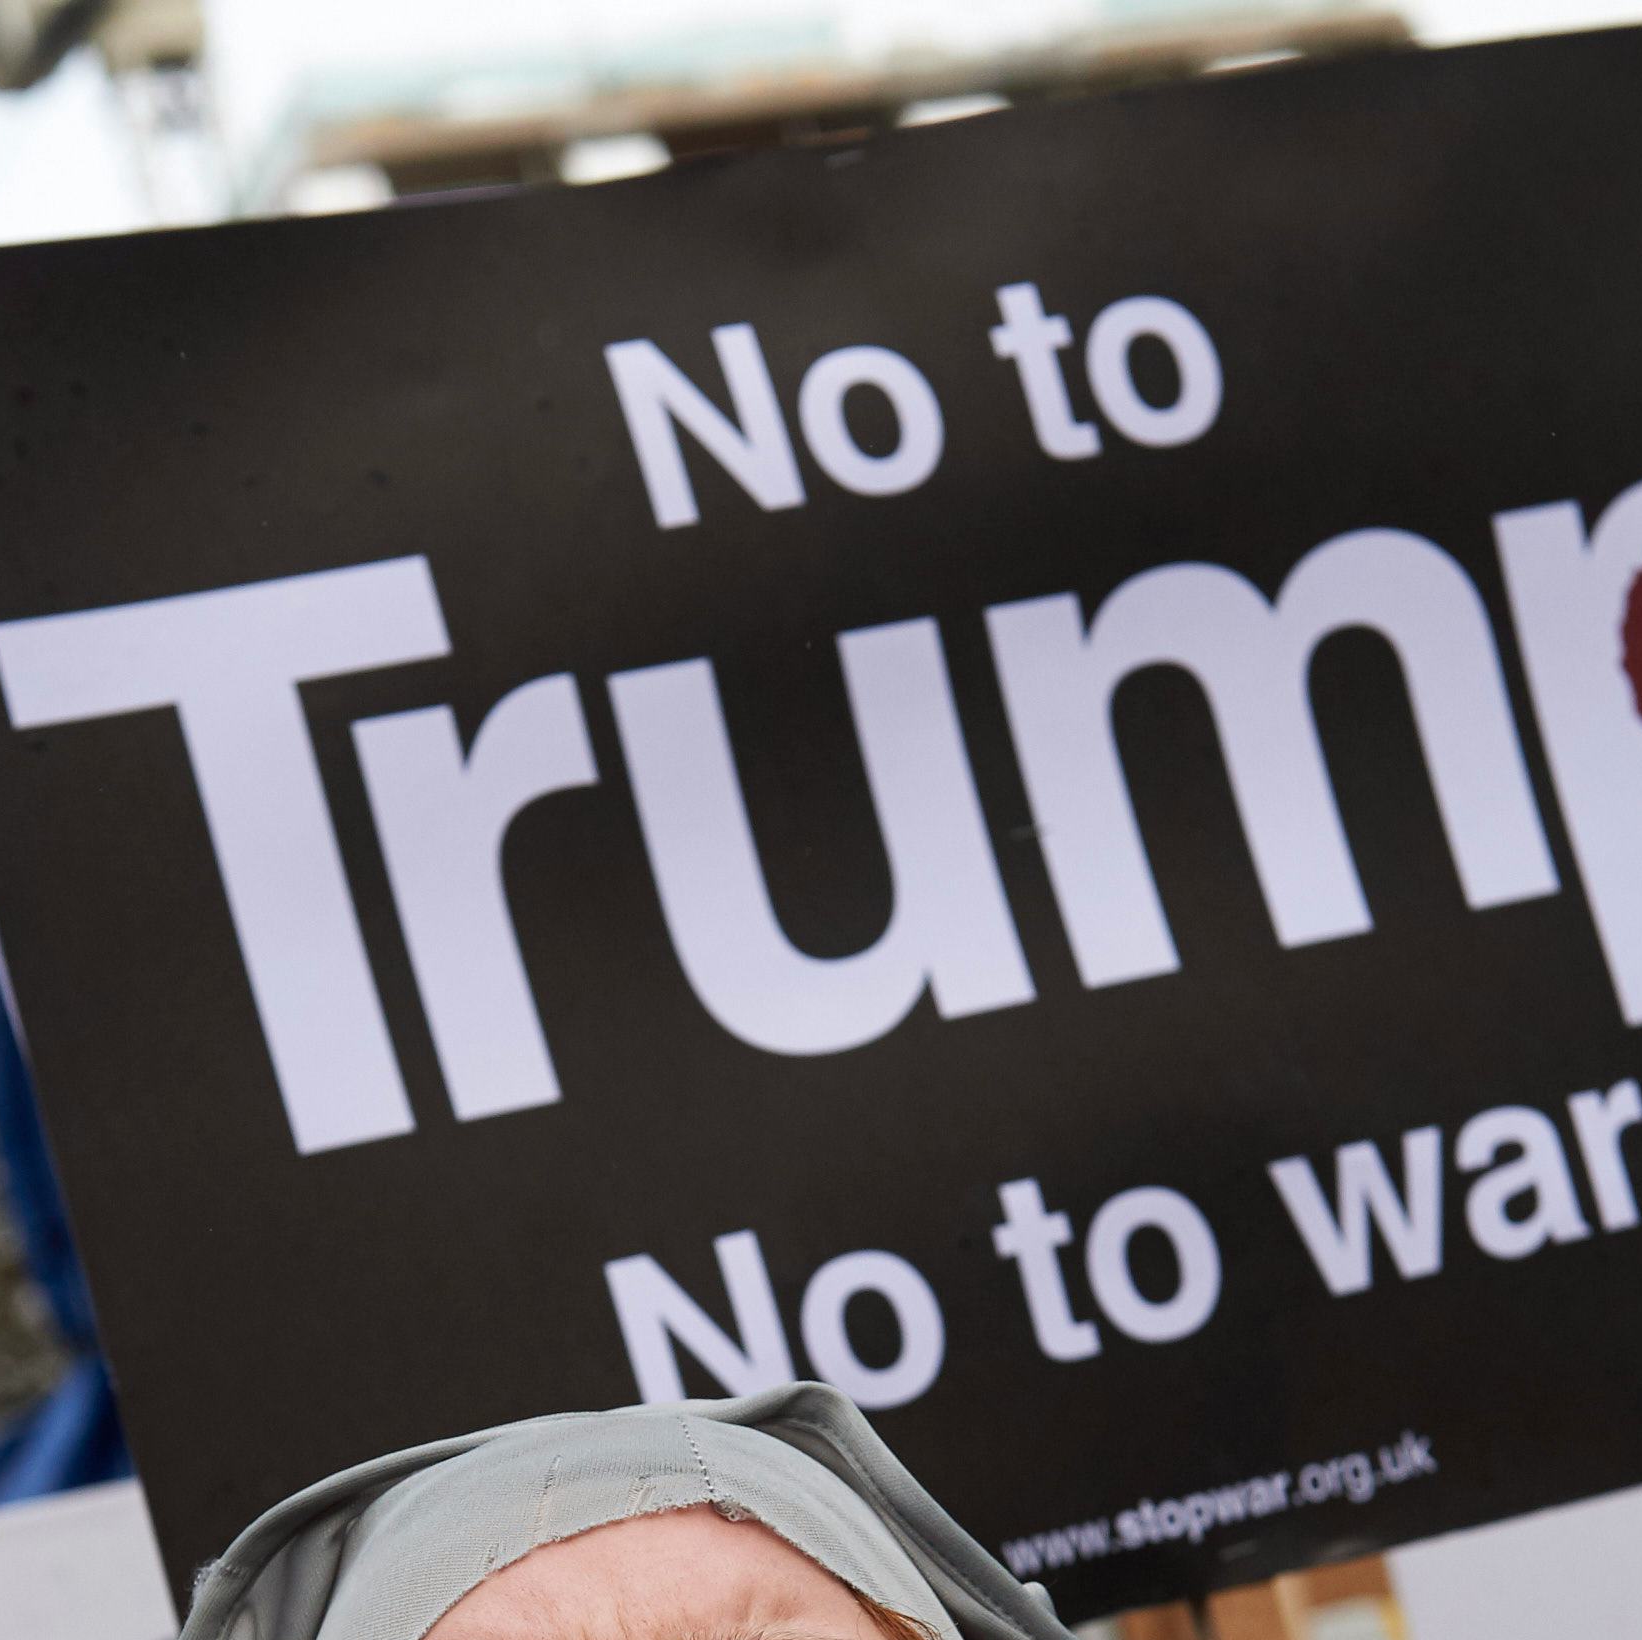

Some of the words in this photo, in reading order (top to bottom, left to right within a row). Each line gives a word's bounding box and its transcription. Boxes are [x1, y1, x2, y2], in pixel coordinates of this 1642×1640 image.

[603, 321, 945, 531] No
[988, 281, 1224, 462] to
[603, 1229, 947, 1410] No
[993, 1177, 1222, 1363] to
[1000, 1428, 1439, 1577] www.stopwar.org.uk
